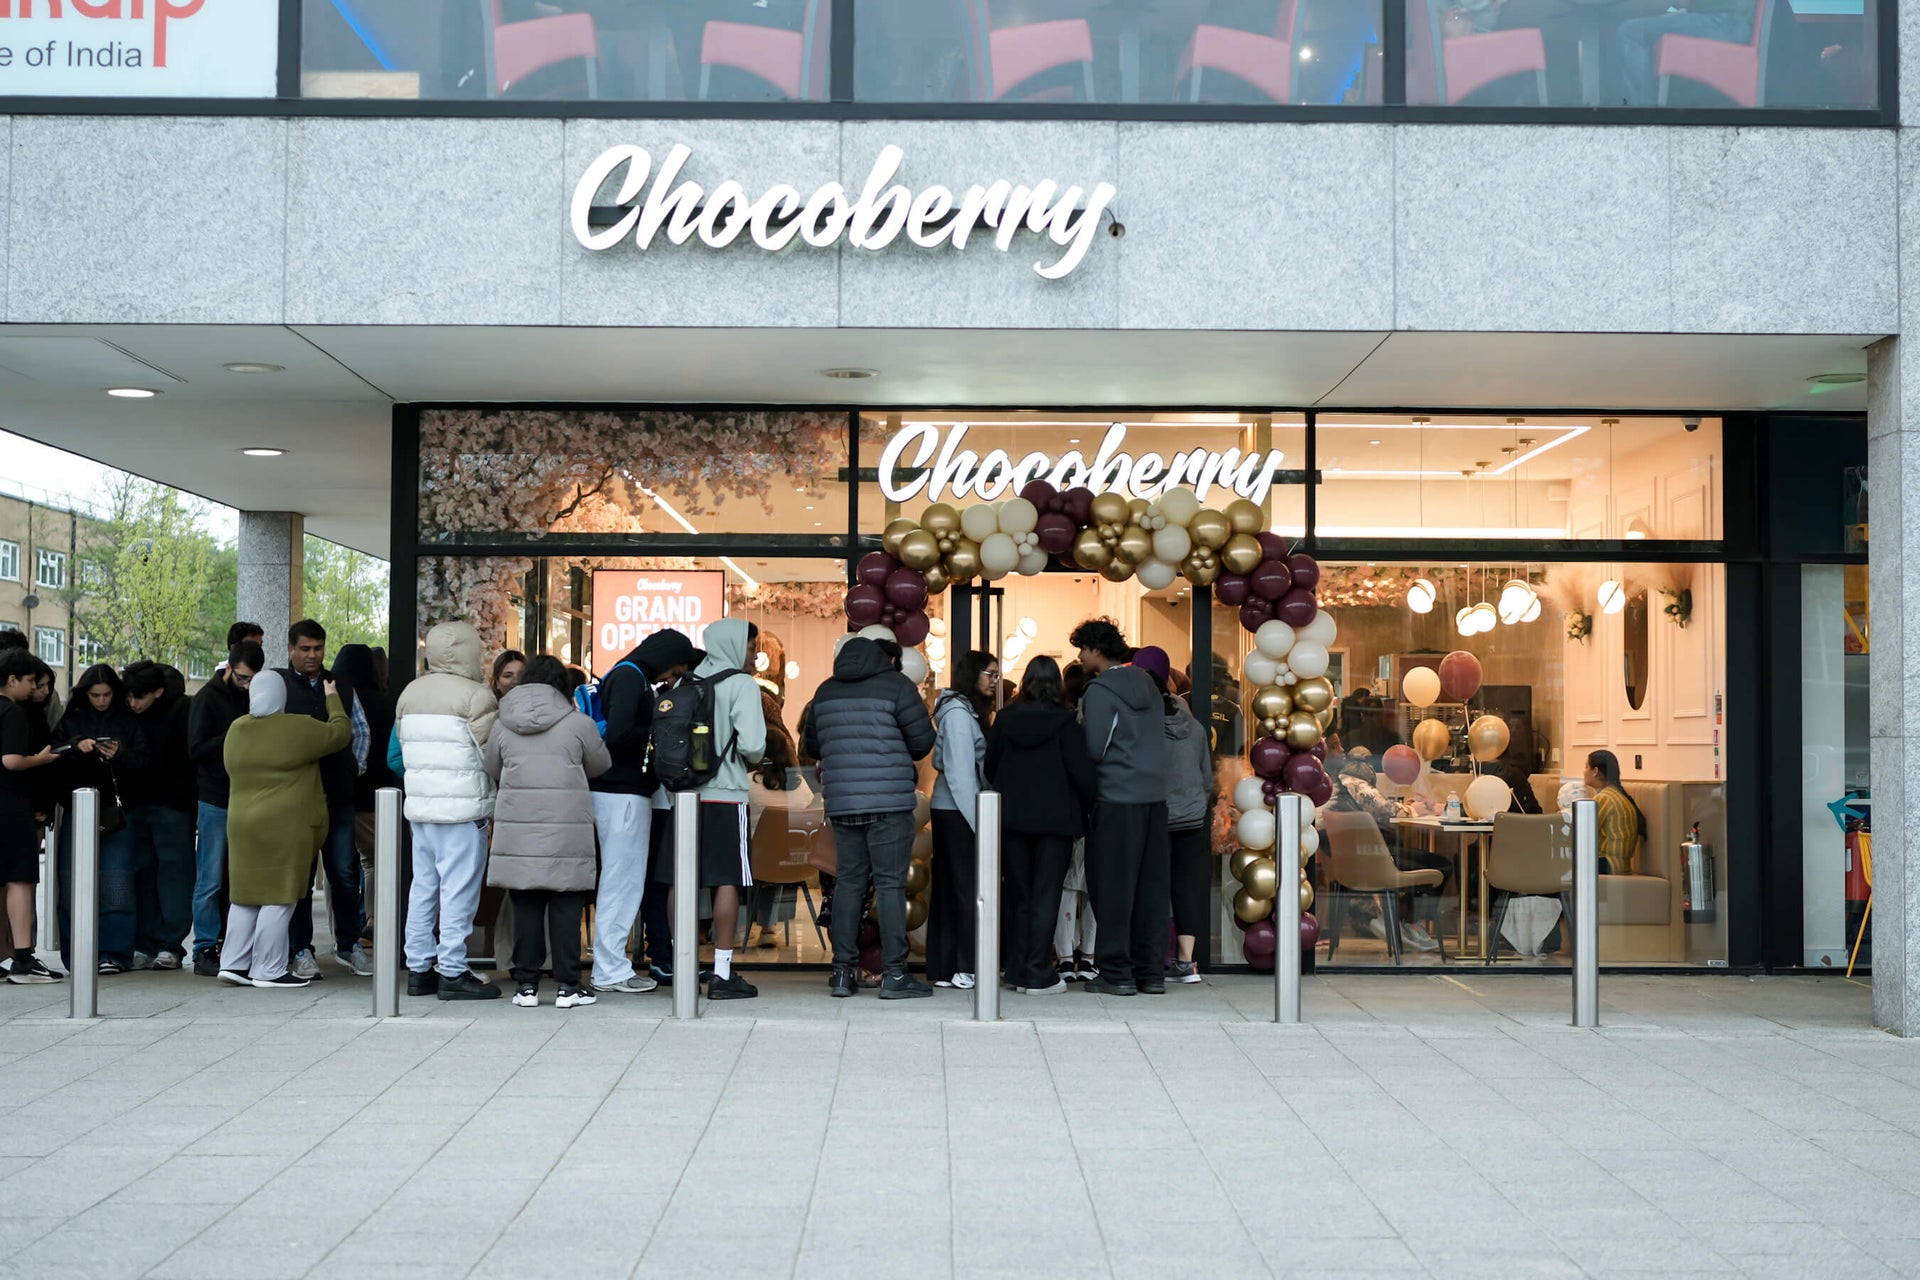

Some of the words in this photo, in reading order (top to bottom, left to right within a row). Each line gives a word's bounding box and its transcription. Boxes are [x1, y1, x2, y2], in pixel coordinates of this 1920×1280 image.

[25, 40, 56, 67] of
[68, 40, 142, 68] India
[571, 143, 1117, 279] Chocoberry
[878, 422, 1285, 506] Chocoberry
[615, 595, 702, 622] GRAND
[1211, 712, 1230, 722] SIL
